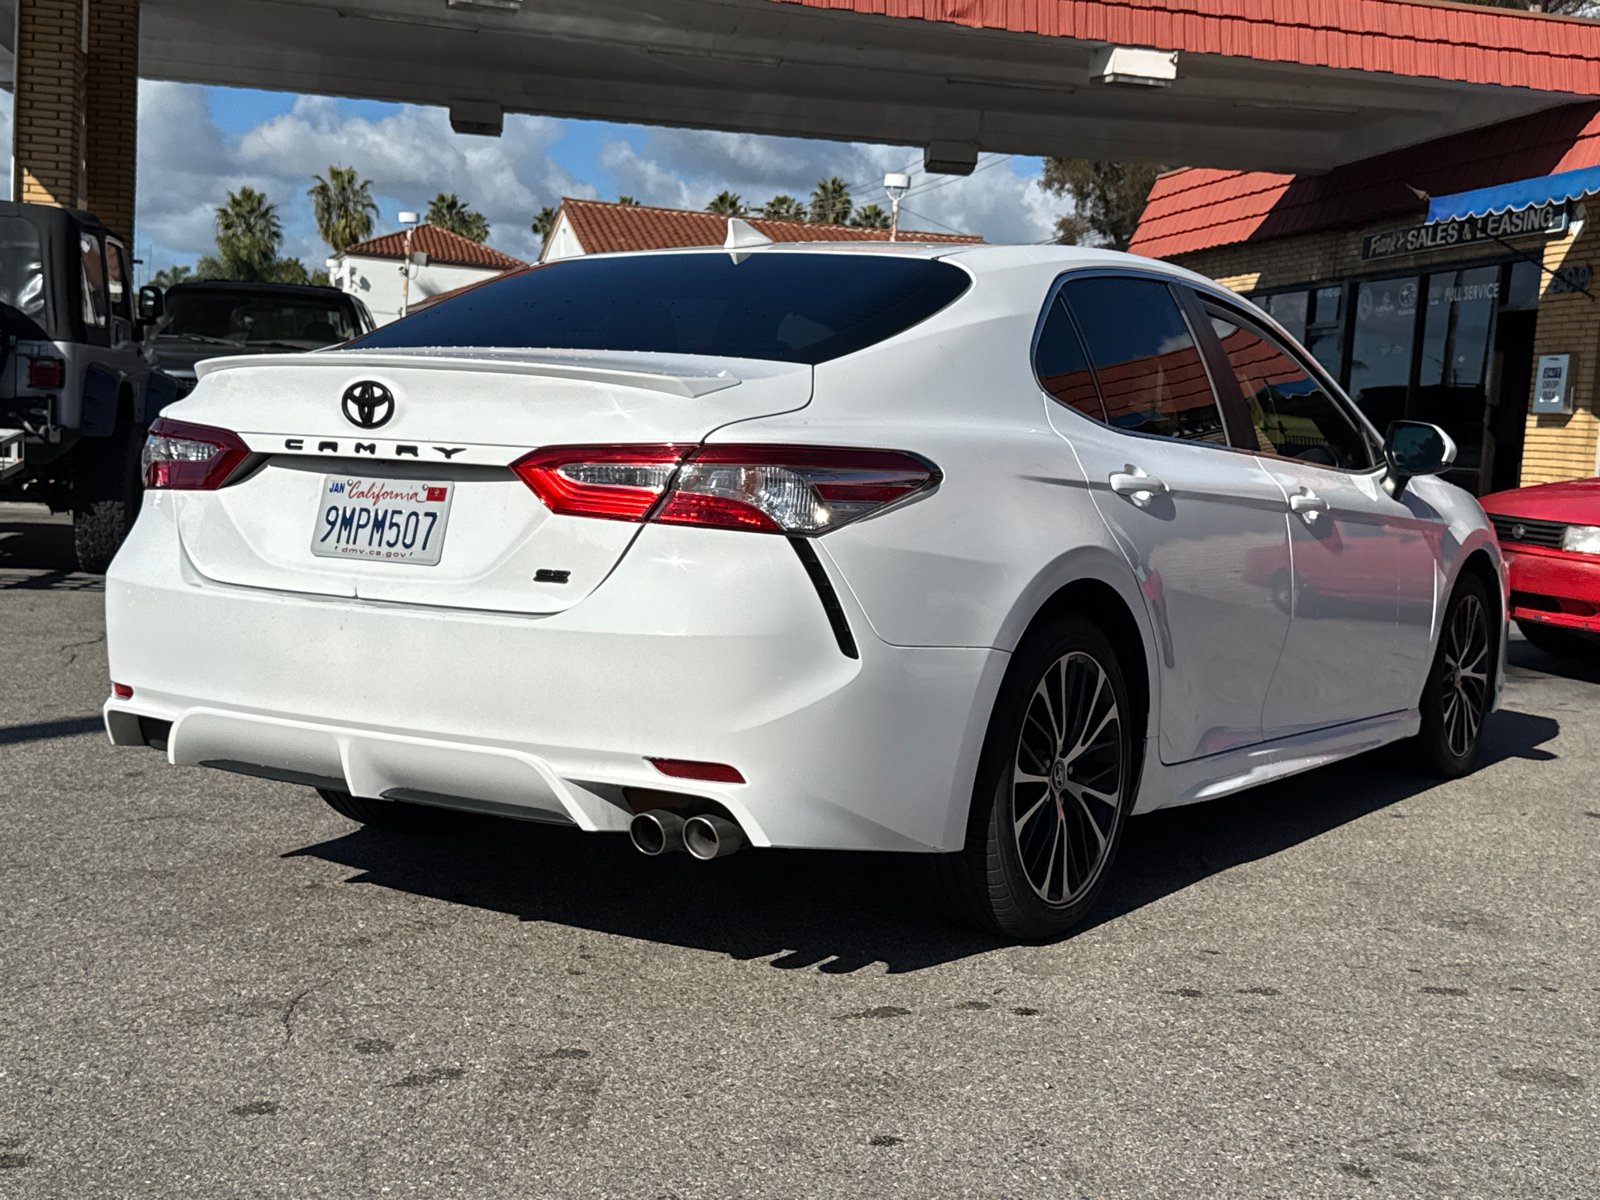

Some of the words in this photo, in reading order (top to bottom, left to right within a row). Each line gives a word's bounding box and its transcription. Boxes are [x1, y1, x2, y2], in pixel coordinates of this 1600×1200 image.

[1406, 222, 1459, 250] SALES
[1462, 222, 1473, 241] &
[1476, 206, 1554, 239] LEASING
[1444, 286, 1462, 303] FULL
[1463, 282, 1500, 301] SERVICE
[1542, 380, 1559, 389] DROP
[1542, 390, 1557, 400] BOX
[285, 439, 467, 459] CAMRY
[329, 482, 346, 493] JAN
[347, 480, 427, 506] California
[320, 505, 438, 551] 9MPM507
[341, 546, 407, 558] dmv.ca.gov
